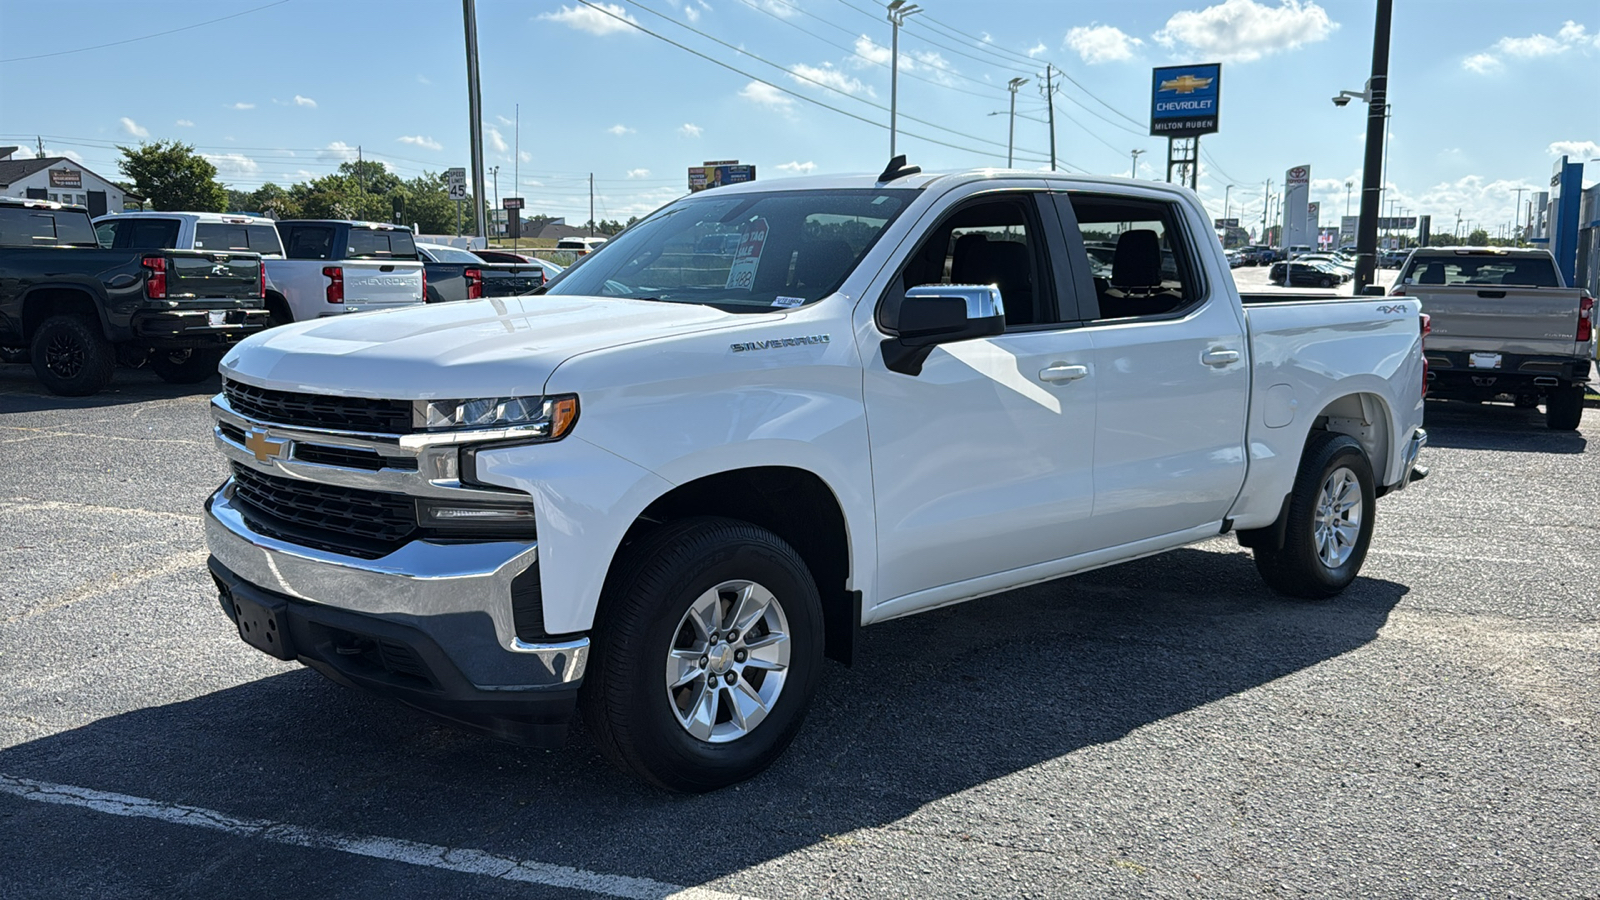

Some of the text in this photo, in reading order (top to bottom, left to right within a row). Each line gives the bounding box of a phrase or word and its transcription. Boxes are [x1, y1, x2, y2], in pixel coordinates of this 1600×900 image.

[1156, 100, 1212, 111] CHEVROLET
[1154, 120, 1213, 130] MILTON RUBEN
[450, 185, 465, 197] 45
[750, 230, 765, 241] TAG
[730, 333, 830, 353] SILVERADO
